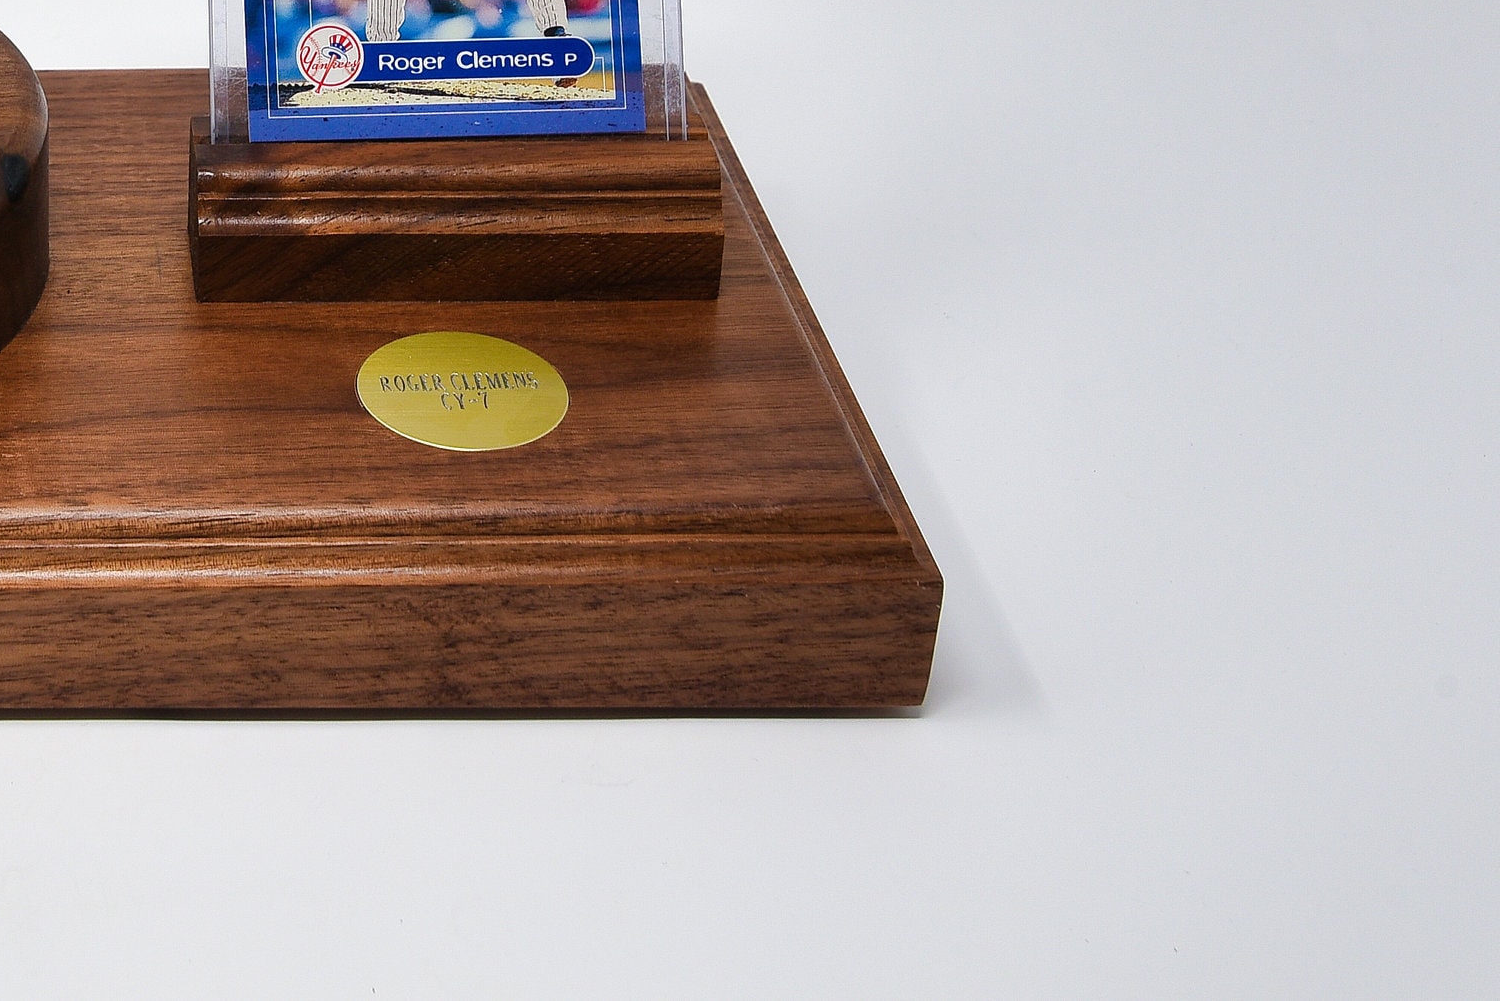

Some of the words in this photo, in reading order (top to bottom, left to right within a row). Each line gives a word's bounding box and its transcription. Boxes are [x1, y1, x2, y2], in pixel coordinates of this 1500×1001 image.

[378, 53, 444, 75] Roger
[456, 50, 554, 70] Clemens
[564, 53, 578, 66] P
[380, 373, 446, 393] ROGER
[450, 371, 540, 391] CLEMENS
[440, 392, 489, 410] CY-7
